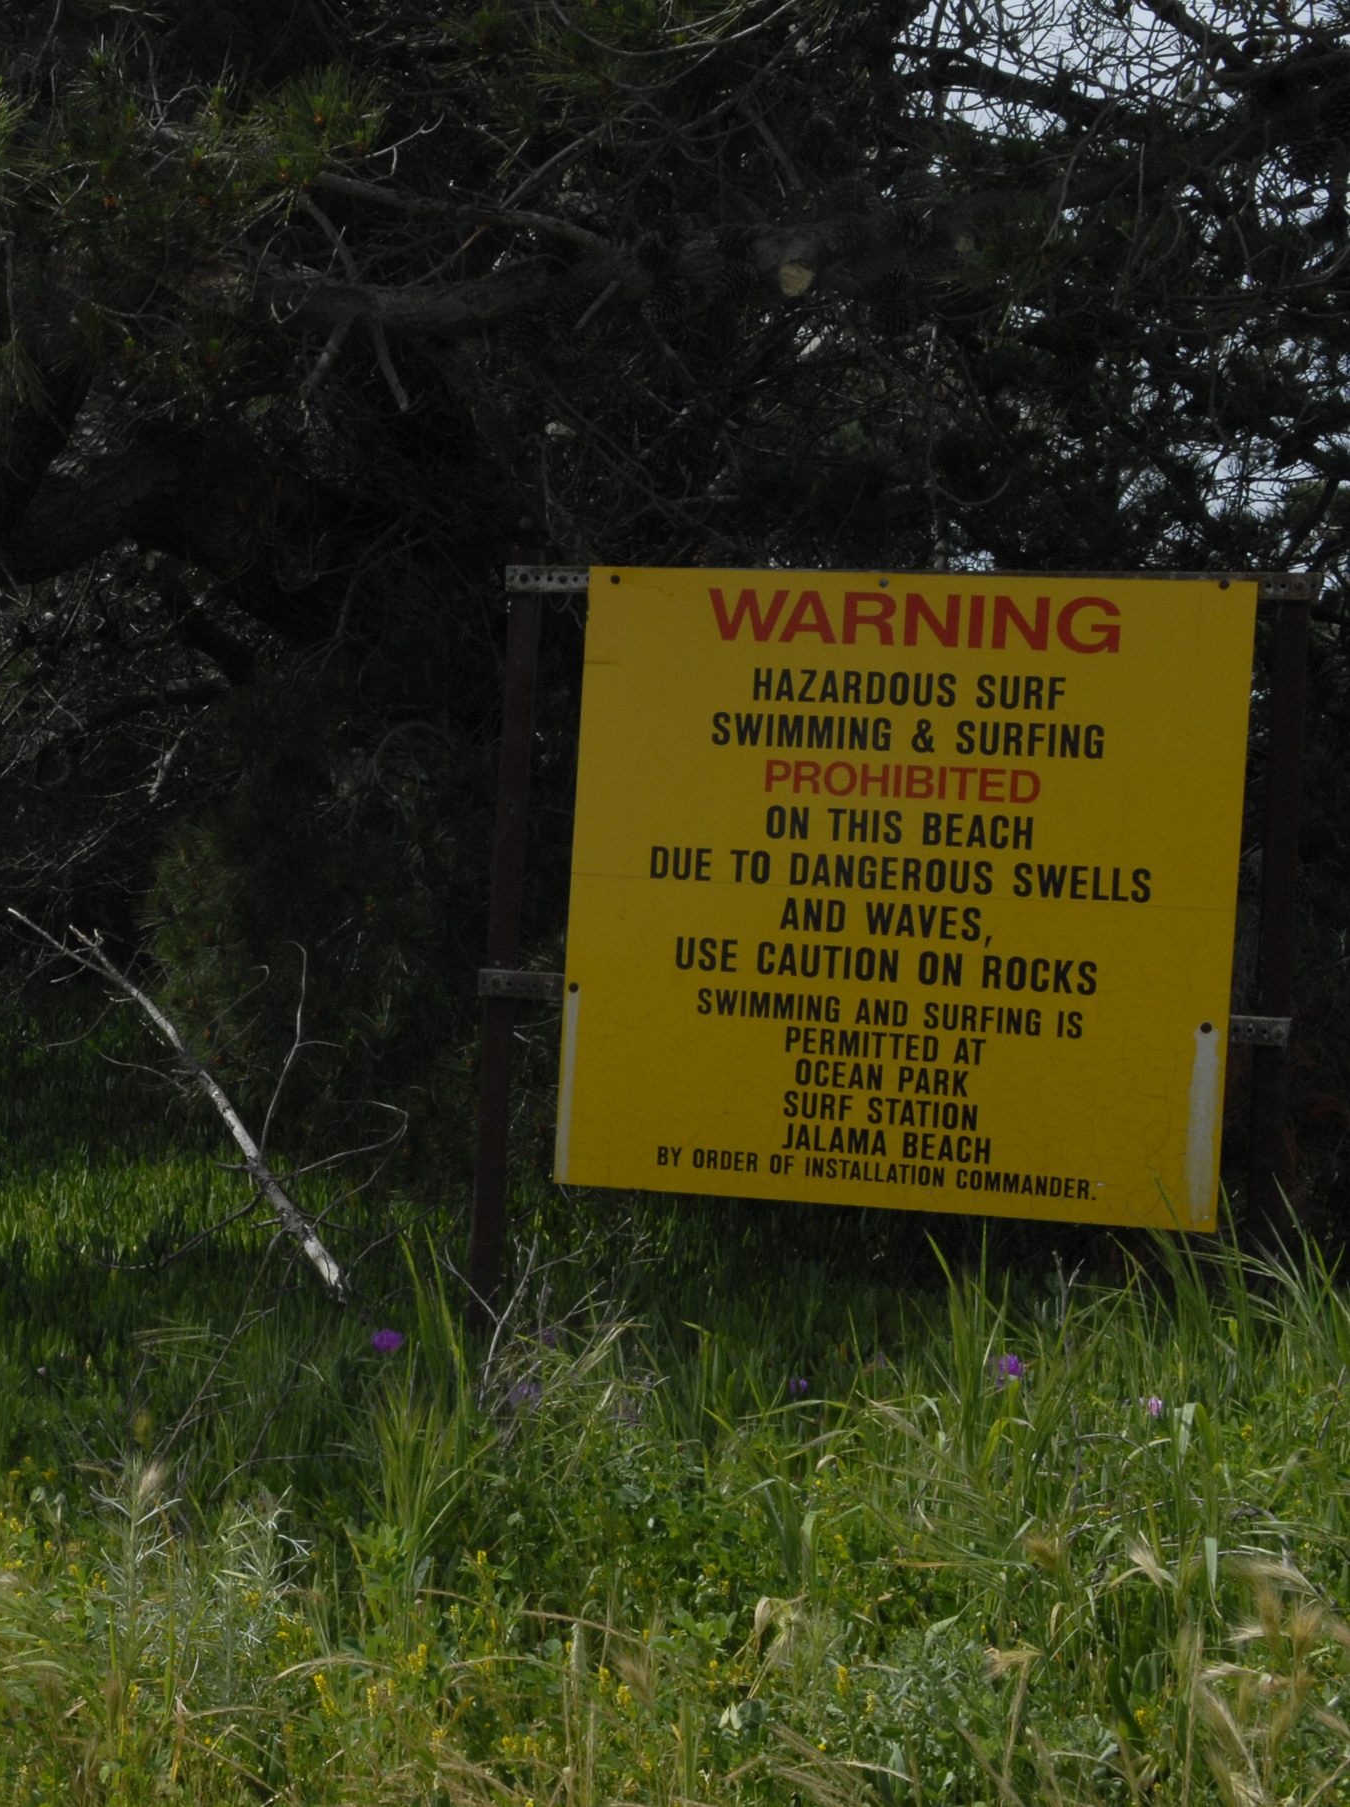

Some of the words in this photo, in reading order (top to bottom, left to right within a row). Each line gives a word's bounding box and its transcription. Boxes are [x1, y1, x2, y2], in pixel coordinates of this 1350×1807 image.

[709, 588, 1120, 654] WARNING
[753, 668, 956, 707] HAZARDOUS
[976, 675, 1066, 710] SURF
[712, 712, 891, 751] SWIMMING
[911, 719, 934, 753] &
[956, 721, 1104, 759] SURFING
[765, 760, 1040, 803] PROHIBITED
[766, 805, 809, 839] ON
[828, 808, 902, 844] THIS
[923, 812, 1033, 850] BEACH
[650, 846, 712, 881] DUE
[731, 850, 770, 884] TO
[790, 853, 992, 895] DANGEROUS
[1013, 863, 1151, 903] SWELLS
[780, 898, 845, 932] AND
[866, 902, 991, 947] WAVES,
[676, 937, 737, 972] USE
[757, 942, 898, 982] CAUTION
[919, 951, 962, 986] ON
[982, 955, 1097, 995] ROCKS
[697, 988, 840, 1023] SWIMMING
[855, 998, 908, 1027] AND
[924, 1002, 1041, 1036] SURFING
[1057, 1011, 1082, 1039] IS
[785, 1026, 938, 1062] PERMITTED
[954, 1038, 986, 1065] AT
[795, 1059, 883, 1090] OCEAN
[898, 1066, 968, 1097] PARK
[784, 1091, 853, 1121] SURF
[868, 1097, 977, 1131] STATION
[782, 1123, 886, 1156] JALAMA
[903, 1132, 990, 1164] BEACH
[657, 1146, 682, 1166] BY
[693, 1148, 758, 1172] ORDER
[770, 1154, 794, 1175] OF
[804, 1157, 945, 1188] INSTALLATION
[956, 1169, 1096, 1200] COMMANDER.
